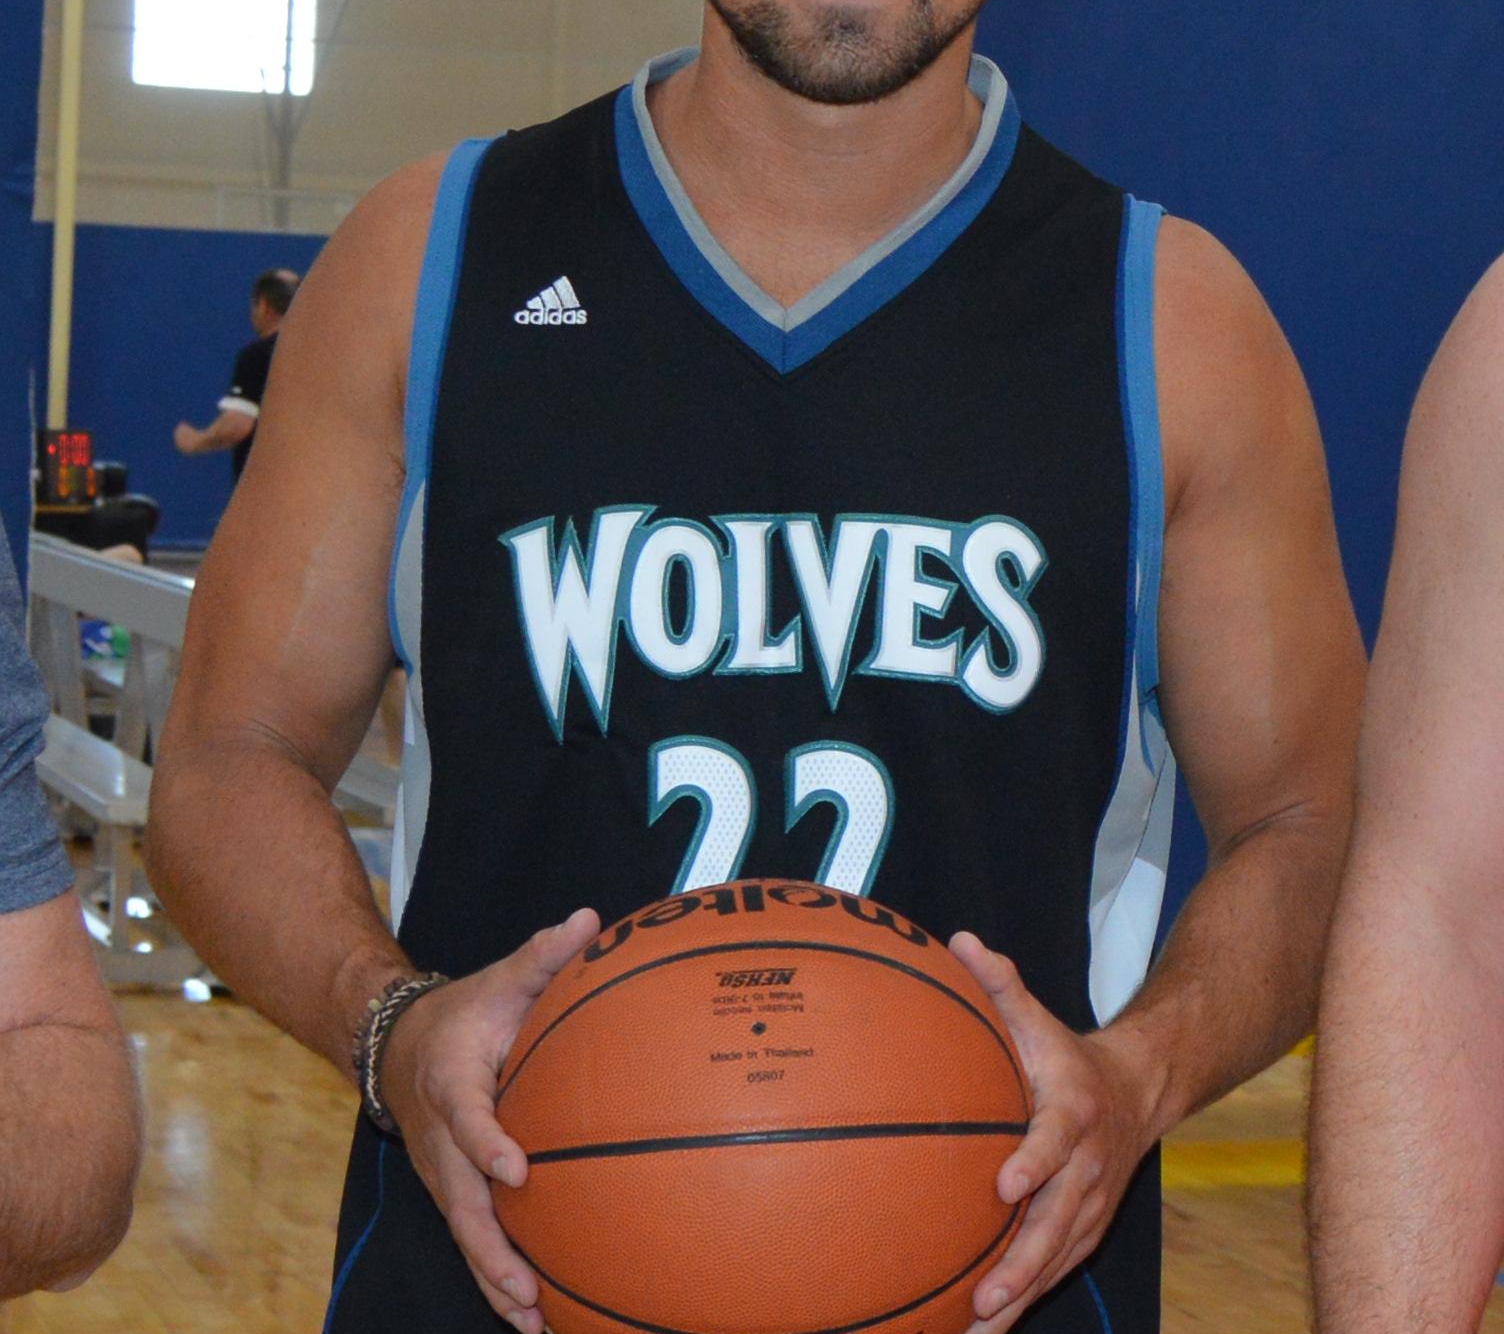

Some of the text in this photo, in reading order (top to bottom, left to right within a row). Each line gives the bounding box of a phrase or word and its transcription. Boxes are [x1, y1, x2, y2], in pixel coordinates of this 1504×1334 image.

[514, 306, 587, 325] adidas
[498, 505, 1049, 745] WOLVES
[582, 881, 929, 964] molten
[710, 1051, 742, 1062] Made
